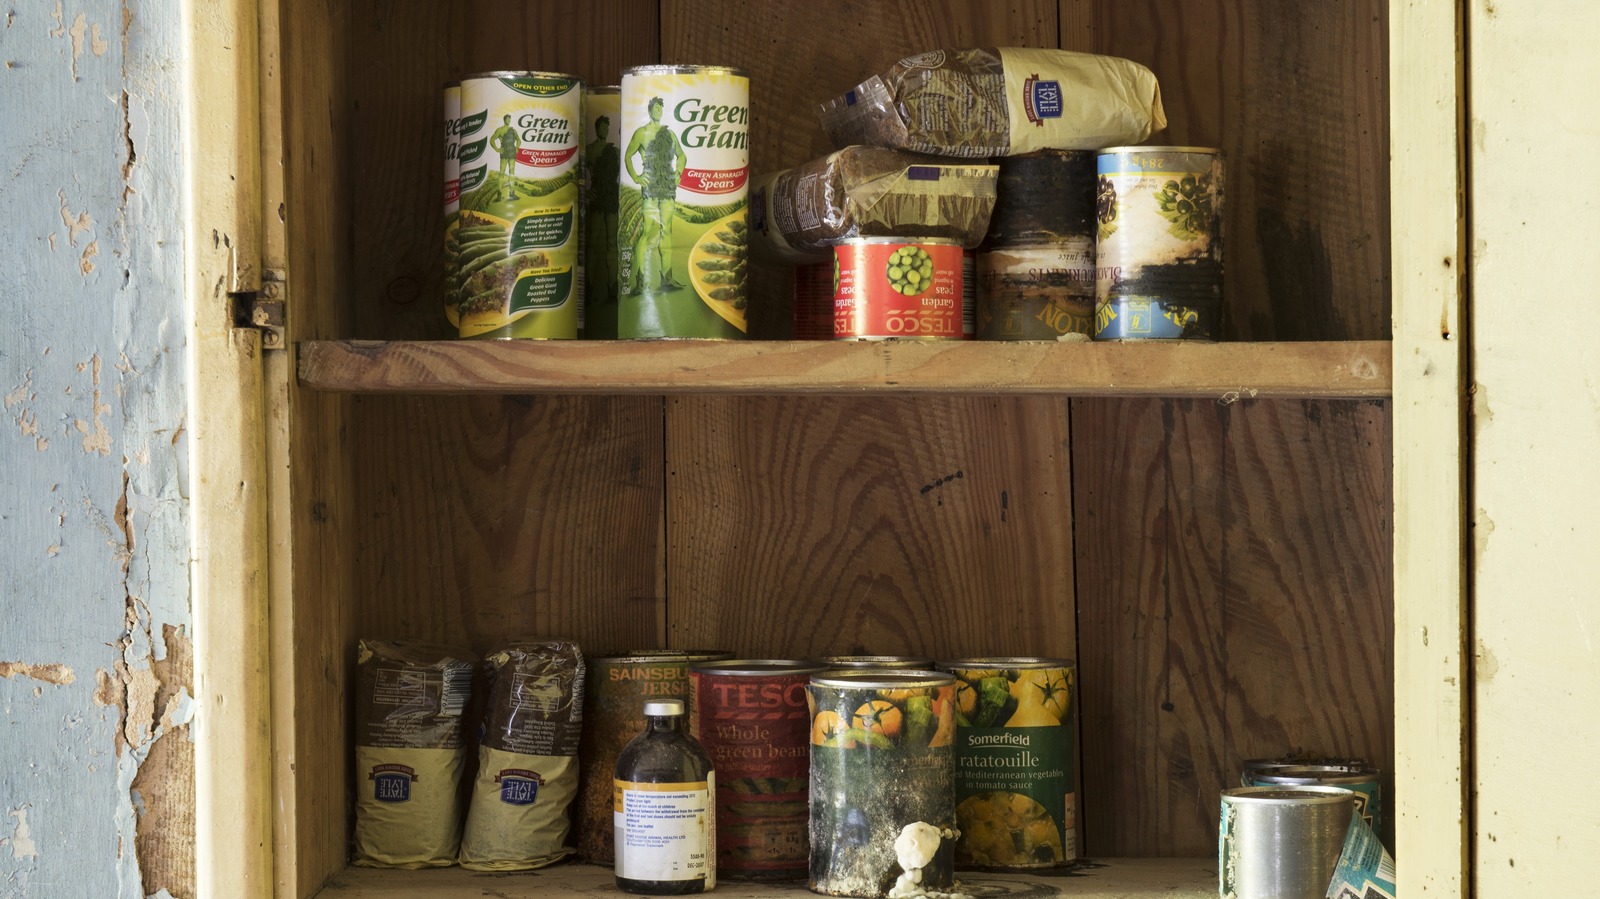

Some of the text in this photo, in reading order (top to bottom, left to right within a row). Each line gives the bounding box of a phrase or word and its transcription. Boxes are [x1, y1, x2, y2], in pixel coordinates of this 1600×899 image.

[1038, 88, 1048, 112] LYLE
[1048, 85, 1058, 112] TATE
[674, 98, 748, 125] Green
[517, 113, 568, 129] Green
[521, 129, 571, 144] Giant
[530, 155, 557, 165] Spears
[687, 170, 744, 178] GREEN ASPARAGUS
[699, 179, 734, 190] Spears
[1058, 252, 1079, 263] juice
[936, 285, 954, 295] peas
[921, 298, 954, 308] Garden
[886, 317, 954, 333] TESCO
[609, 668, 688, 681] SAINSBU
[713, 683, 807, 708] TESC
[717, 724, 769, 740] Whole
[968, 732, 1030, 746] Somerfield
[716, 745, 763, 760] green
[960, 751, 1039, 768] ratatouille
[965, 771, 1025, 779] Mediterranean
[1028, 769, 1064, 780] vegetables
[381, 779, 403, 788] LYLE
[508, 782, 531, 792] LYLE
[966, 781, 973, 789] in
[380, 788, 405, 798] TATE
[507, 790, 531, 801] TATE
